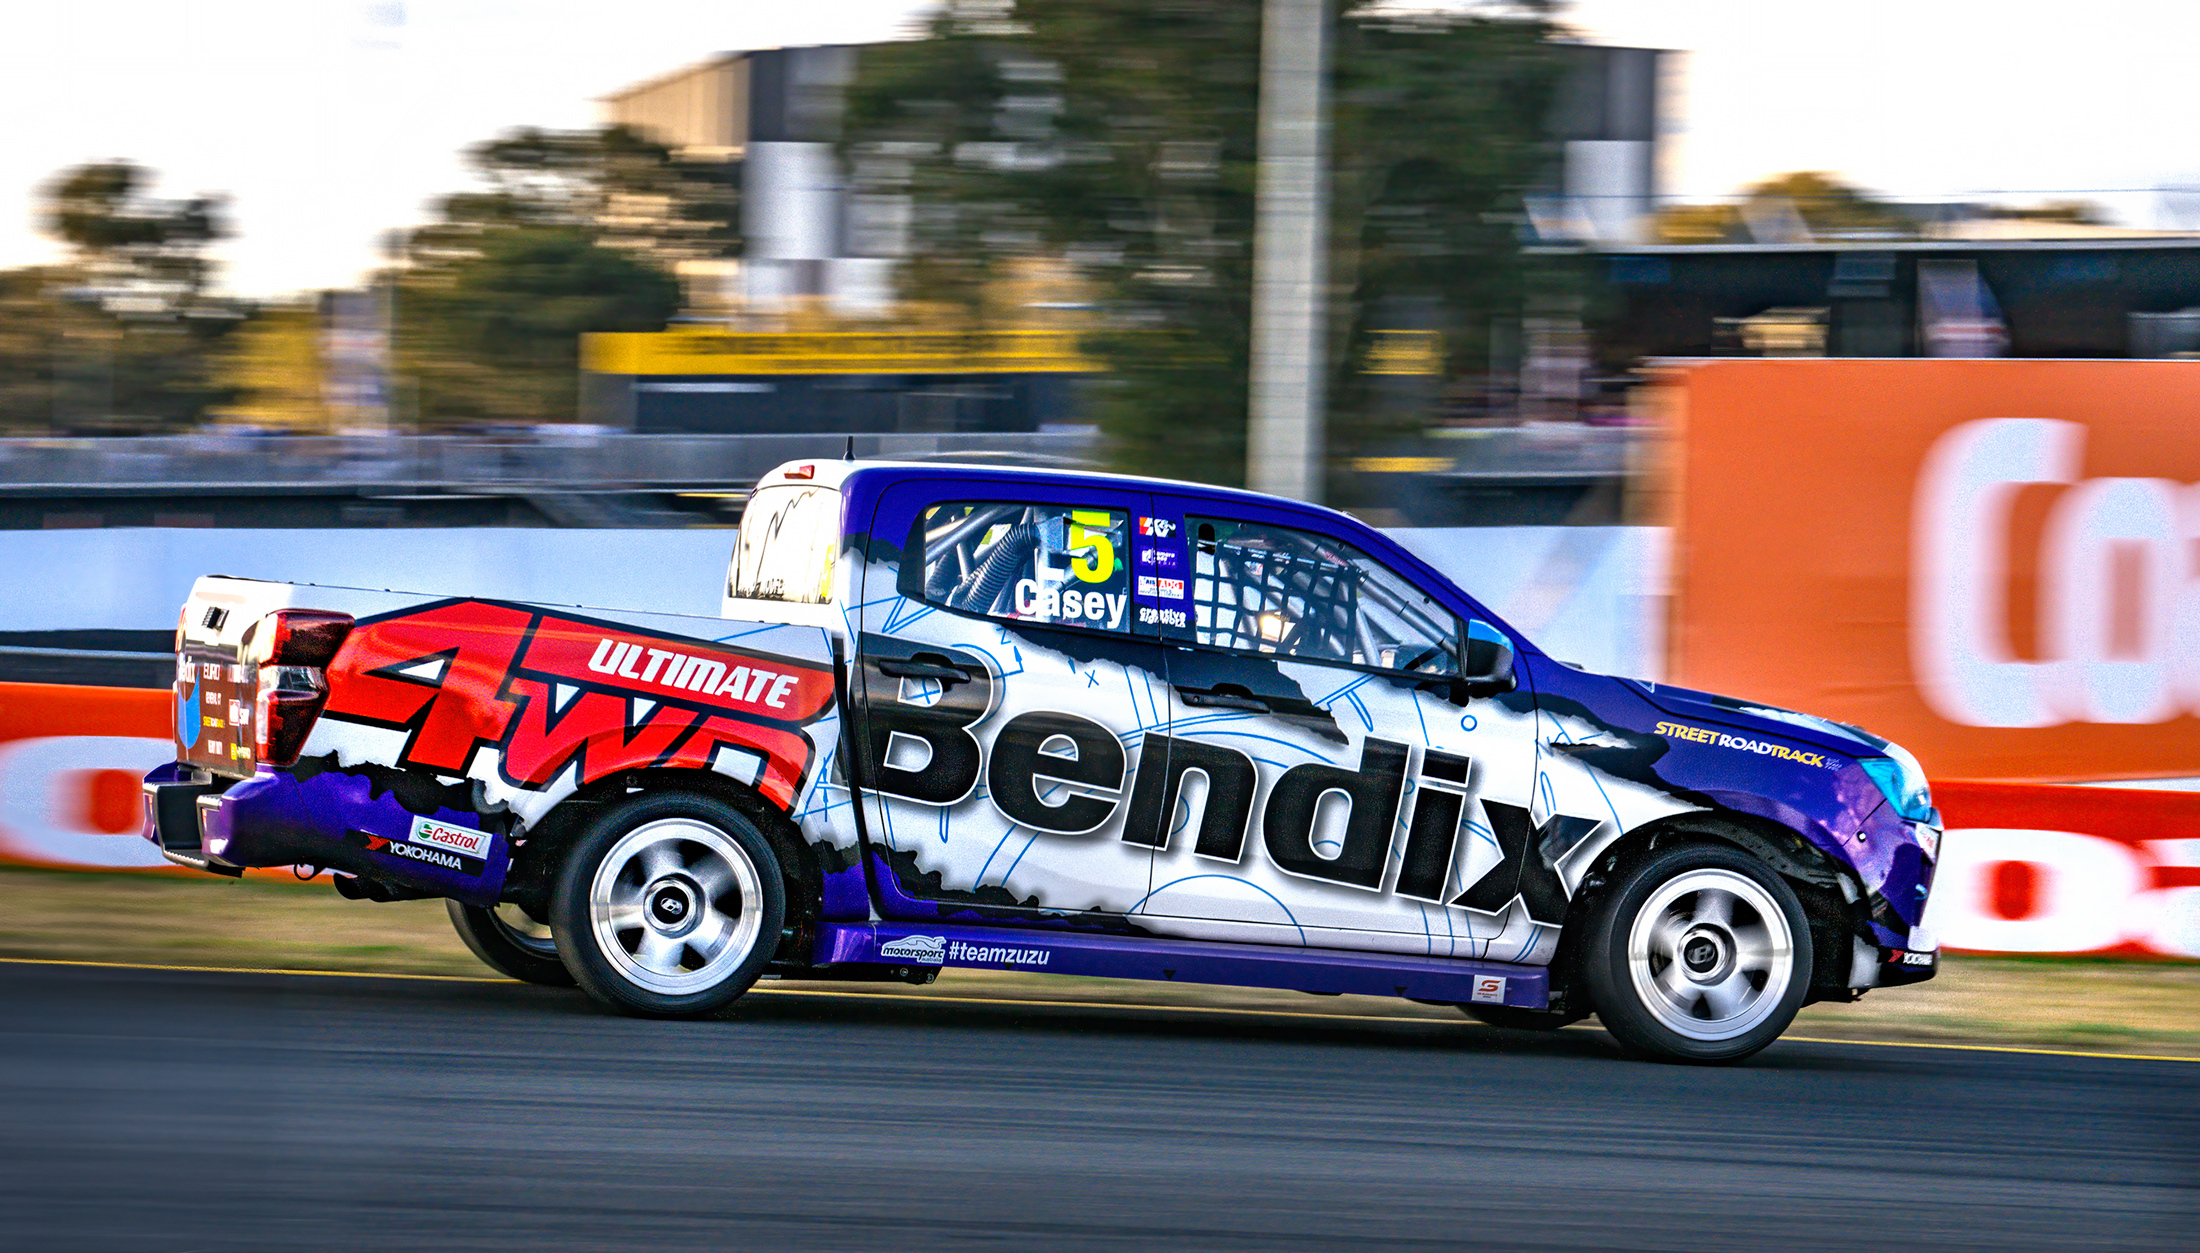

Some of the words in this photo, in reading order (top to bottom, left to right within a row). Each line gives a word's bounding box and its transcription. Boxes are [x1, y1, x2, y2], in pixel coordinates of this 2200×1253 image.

[1070, 509, 1115, 584] 5
[1015, 578, 1127, 629] Casey
[588, 638, 799, 709] ULTIMATE
[832, 632, 1601, 927] Bendix
[389, 841, 463, 870] YOKOHAMA
[432, 827, 480, 850] Castrol
[882, 946, 945, 961] motorsport
[949, 941, 1050, 966] #teamzuzu
